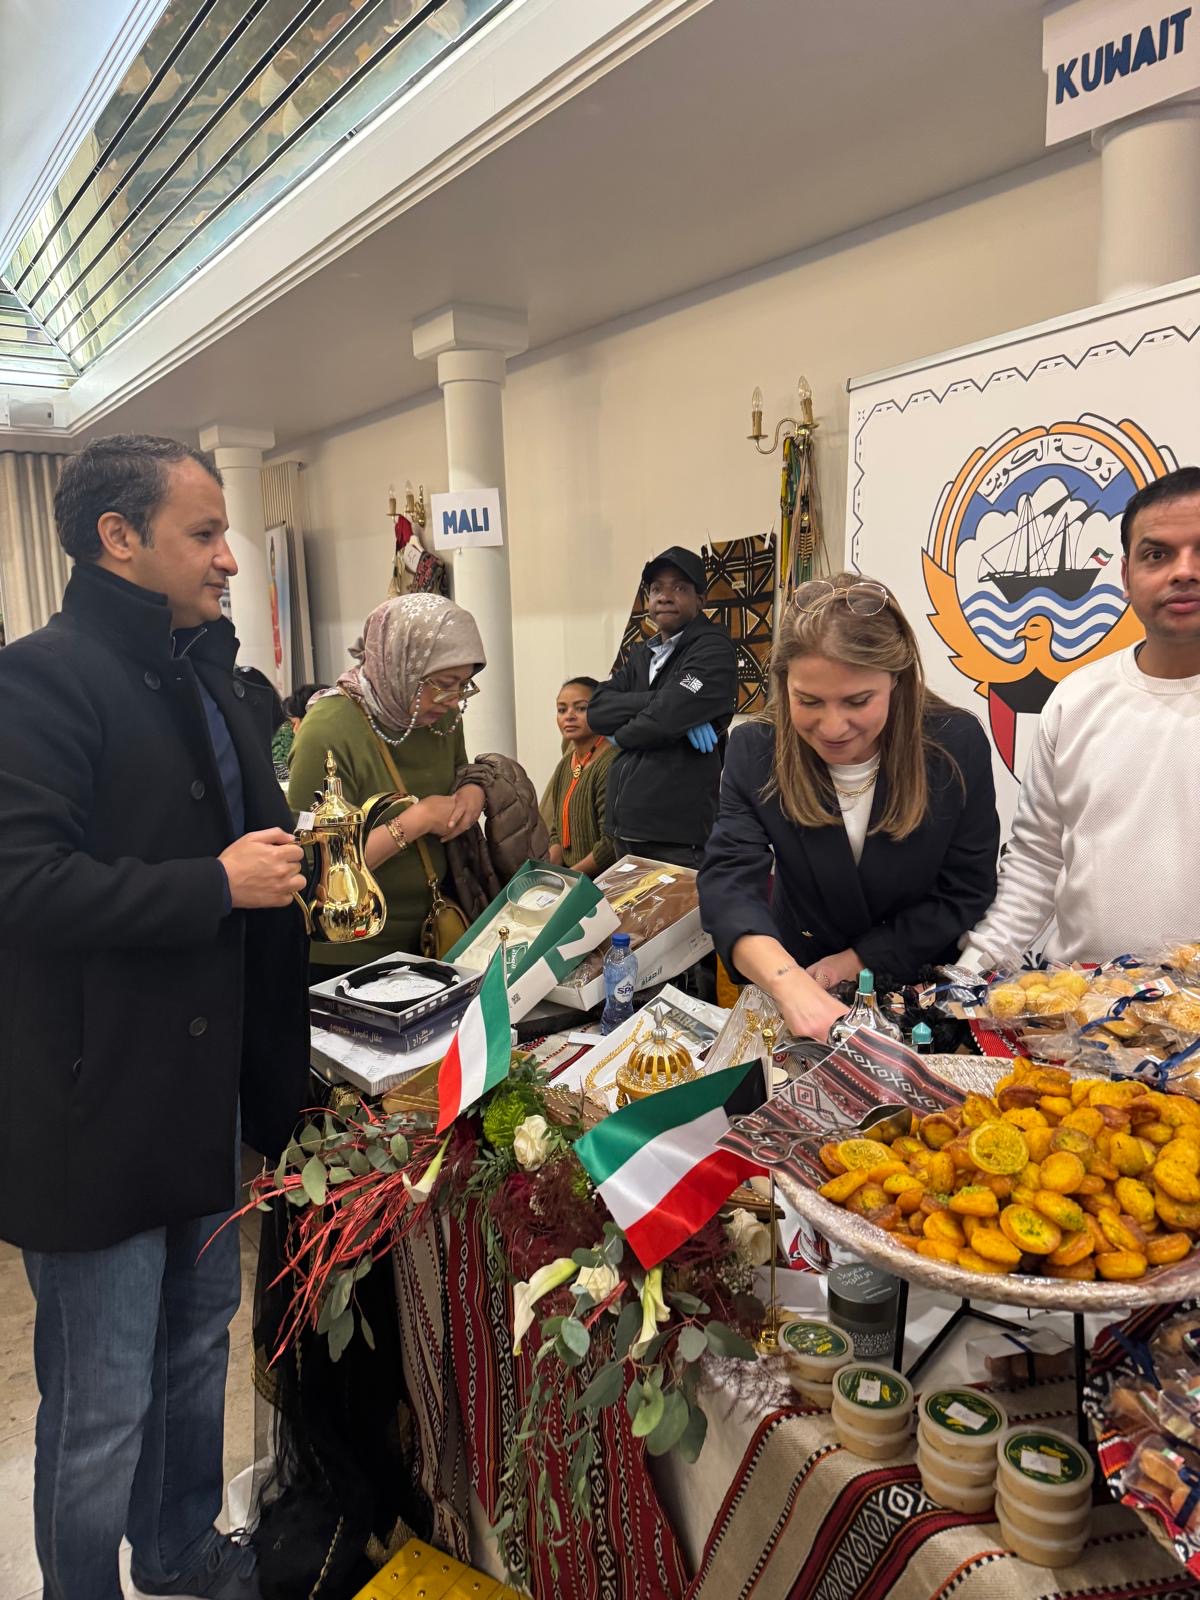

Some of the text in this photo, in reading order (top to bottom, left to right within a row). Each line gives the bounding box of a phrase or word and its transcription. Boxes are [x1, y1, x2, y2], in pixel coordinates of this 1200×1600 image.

[1055, 6, 1192, 106] KUWAIT
[983, 438, 1050, 497] الكويت
[442, 507, 490, 535] MALI
